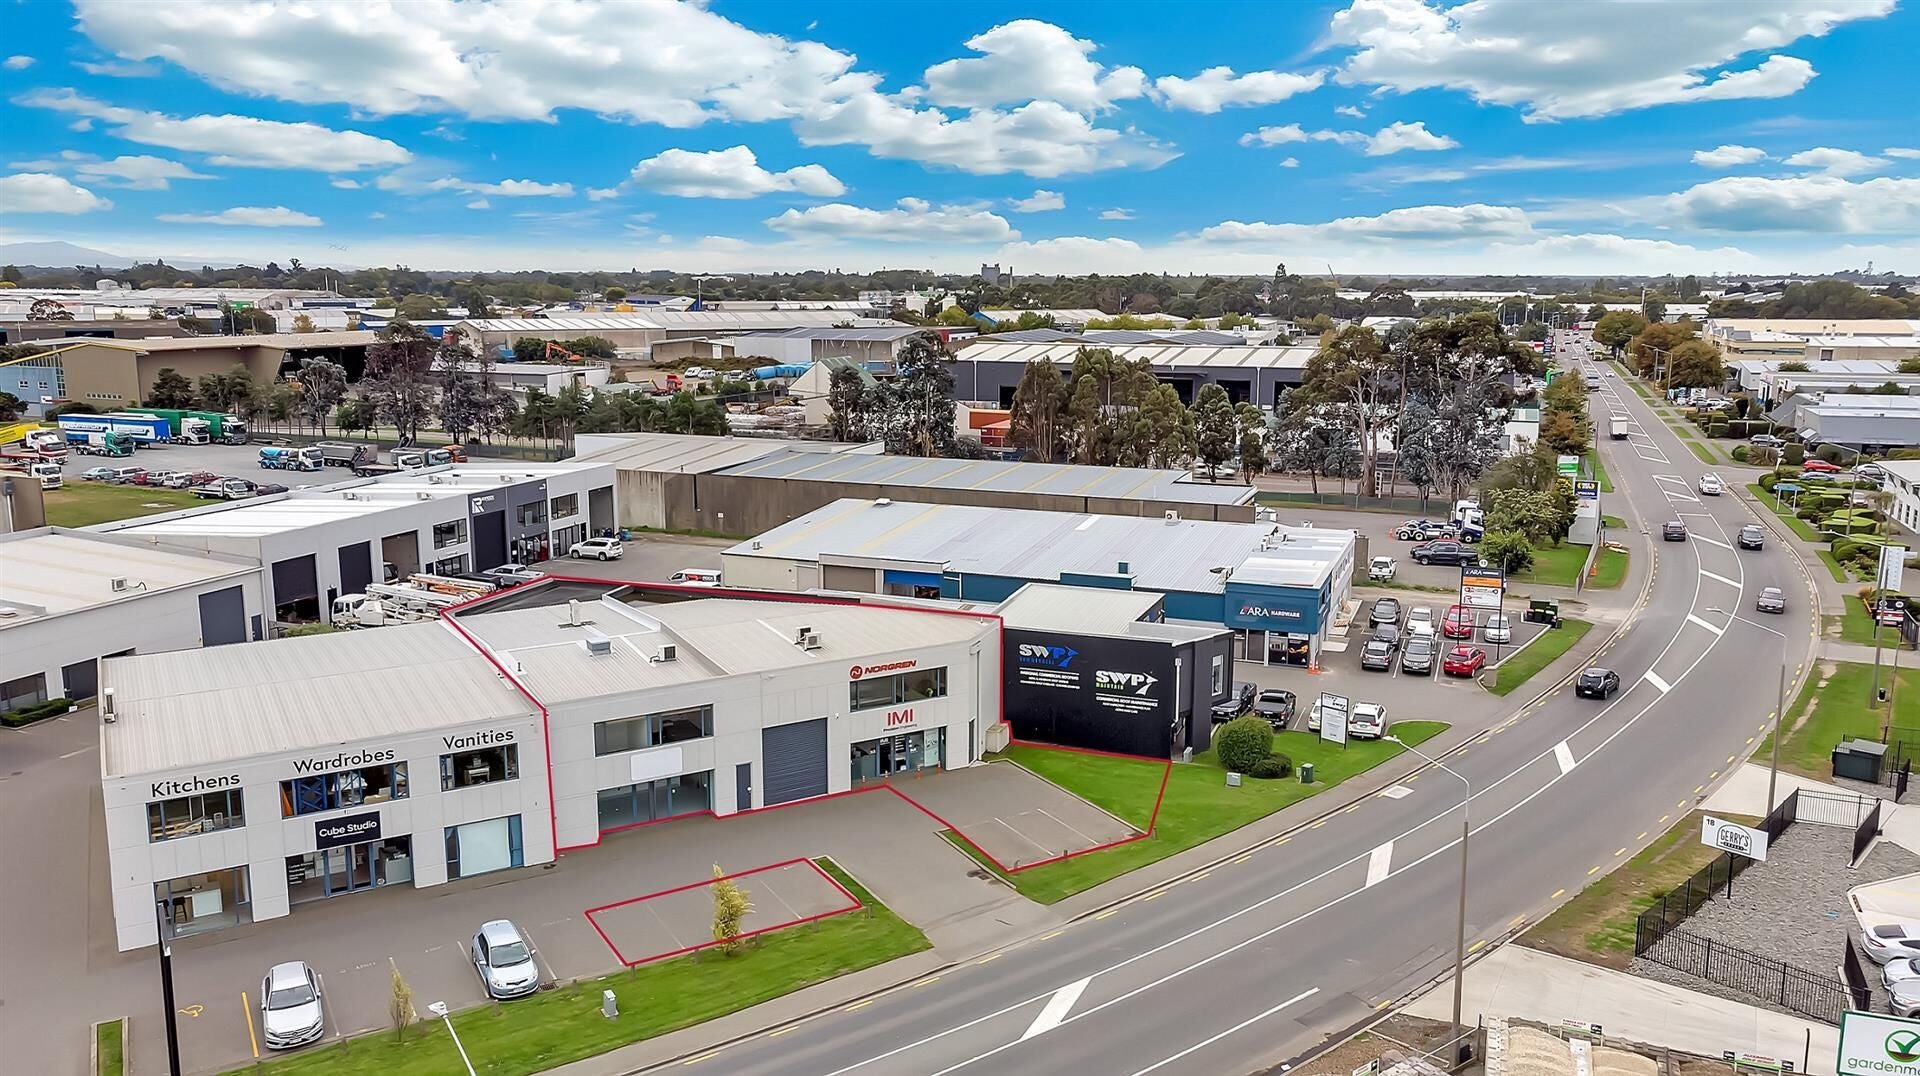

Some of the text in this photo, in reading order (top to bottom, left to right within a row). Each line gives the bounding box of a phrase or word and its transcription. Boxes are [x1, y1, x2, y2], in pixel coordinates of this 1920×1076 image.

[1270, 610, 1300, 618] HARDWARE
[1019, 643, 1066, 659] SWP
[864, 660, 917, 674] NORGREN
[1095, 670, 1145, 686] SWP
[887, 708, 913, 726] IMI
[442, 729, 514, 750] Vanities
[293, 749, 394, 774] Wardrobes
[151, 774, 240, 798] Kitchens
[319, 827, 346, 837] Cube
[346, 820, 377, 832] Studio
[1706, 818, 1715, 826] 18
[1720, 828, 1749, 848] GERRY'S
